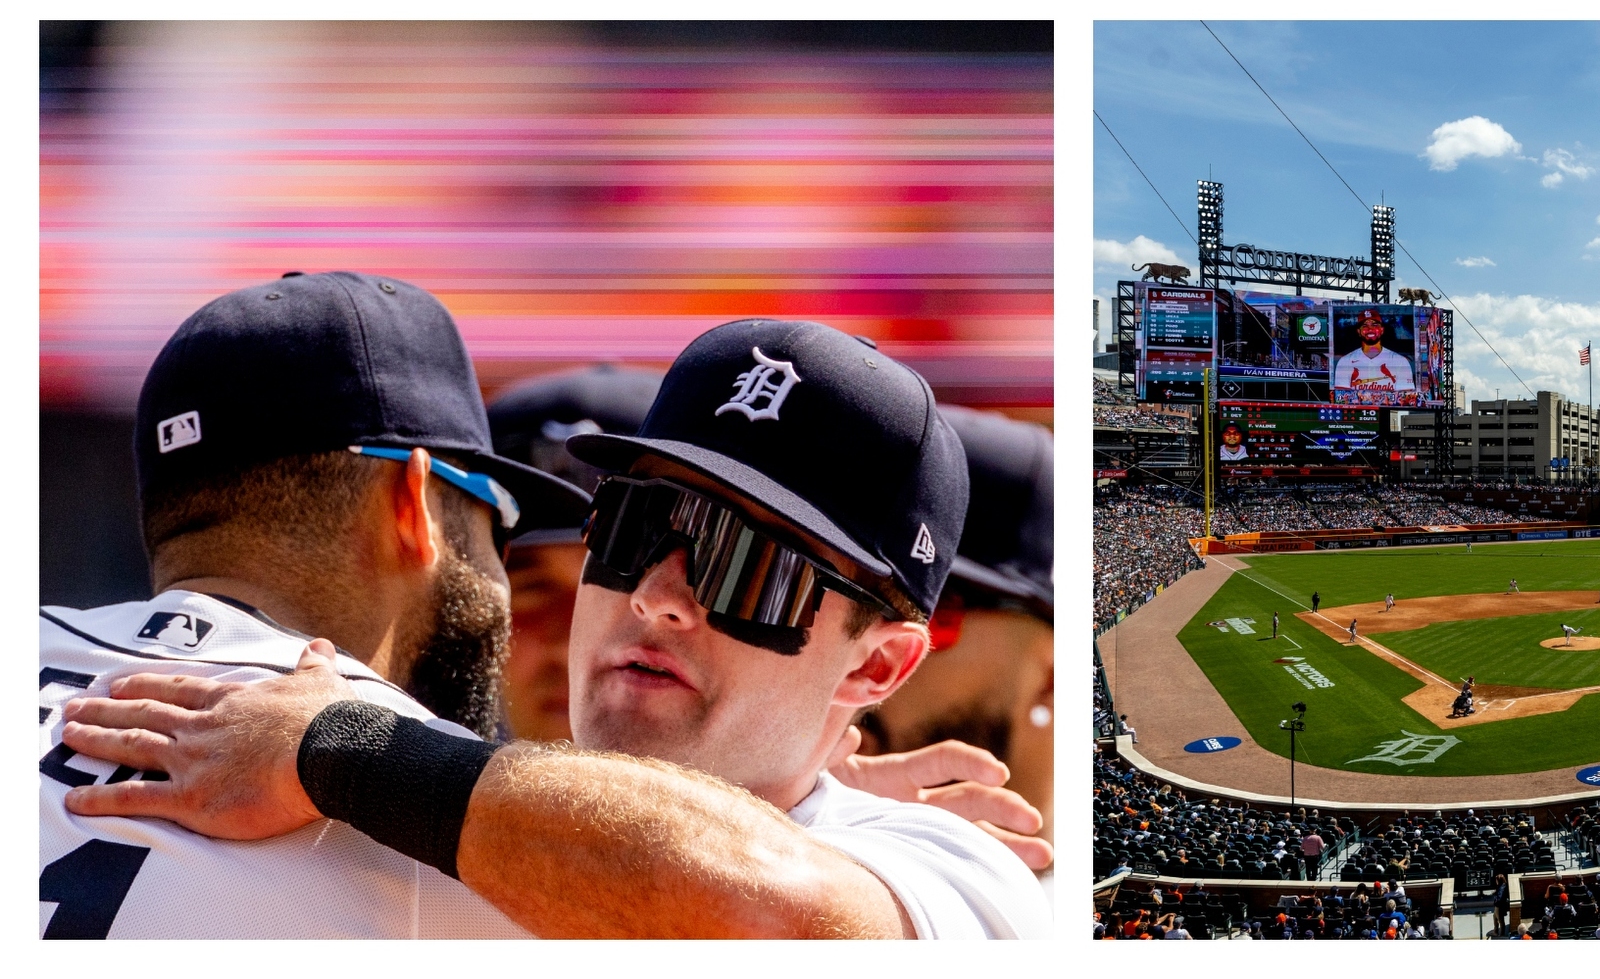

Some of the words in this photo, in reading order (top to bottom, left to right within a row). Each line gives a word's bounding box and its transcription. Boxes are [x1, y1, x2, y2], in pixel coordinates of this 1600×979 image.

[1269, 270, 1331, 285] PARK
[1161, 291, 1206, 300] CARDINALS
[1264, 370, 1308, 378] HERRERA
[715, 347, 801, 422] D
[1294, 662, 1336, 688] VICTORS
